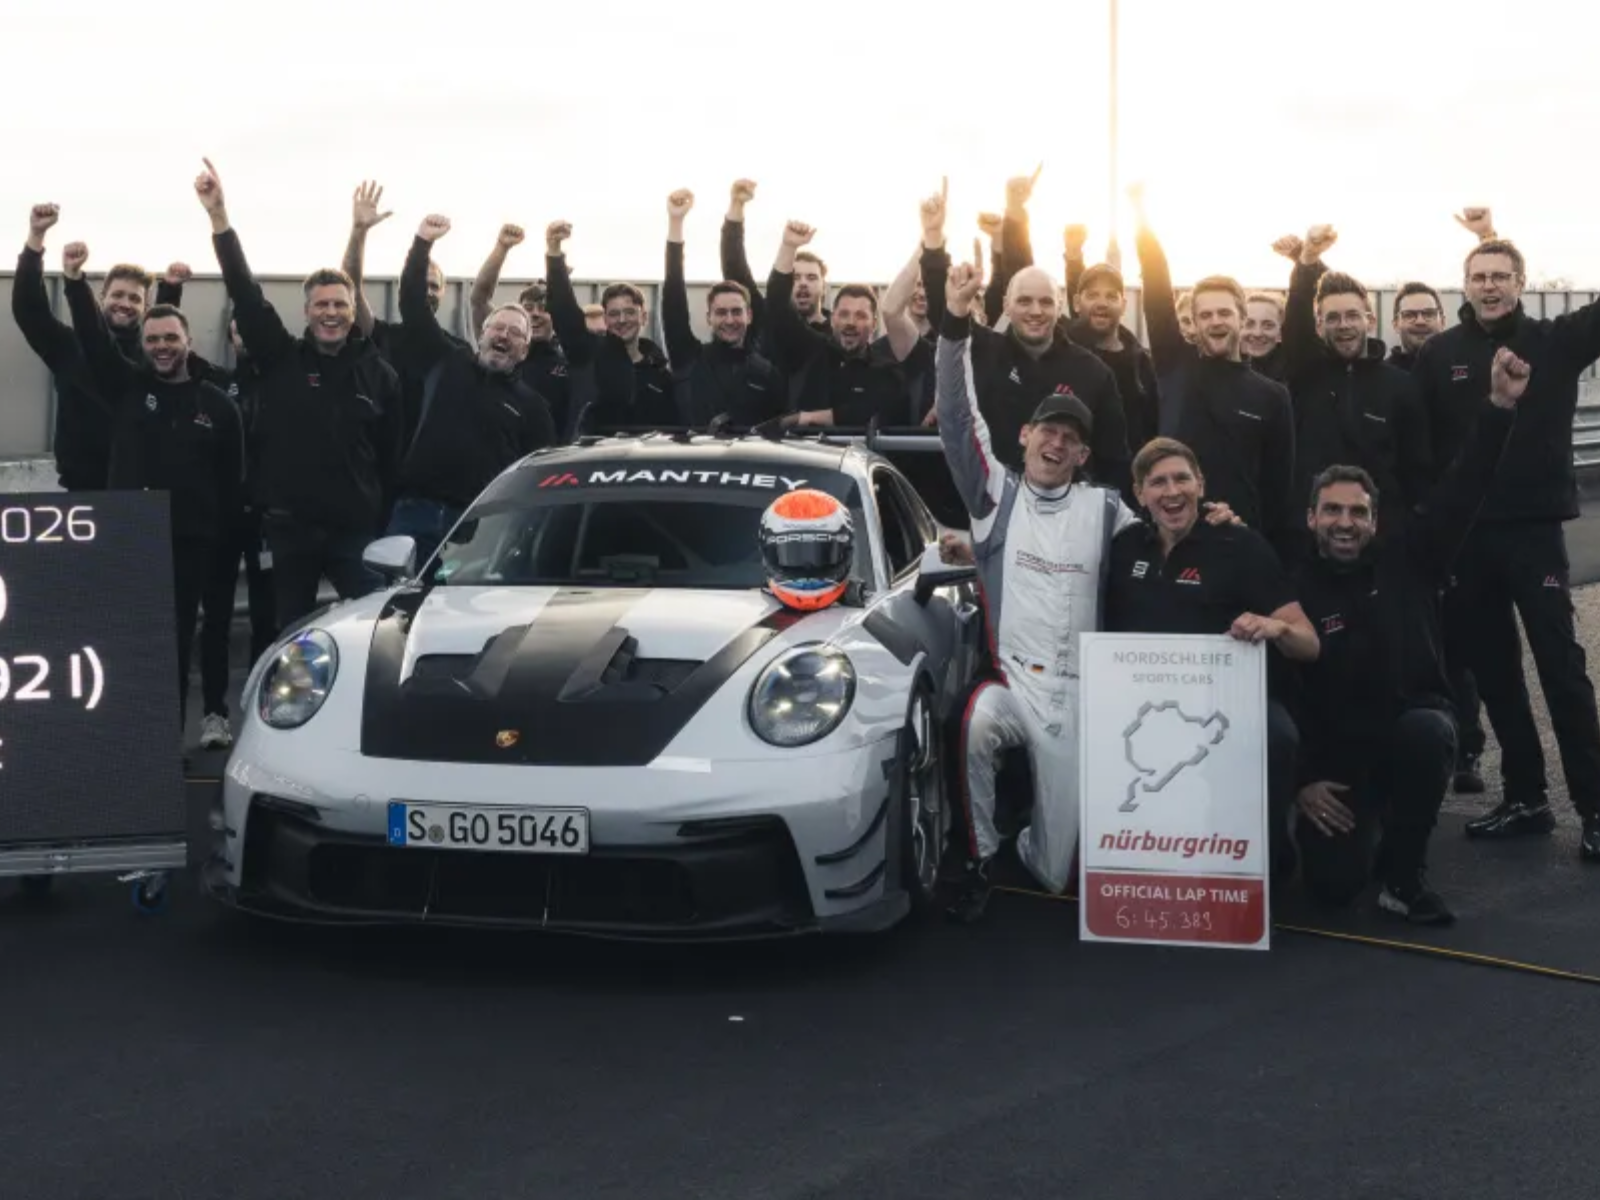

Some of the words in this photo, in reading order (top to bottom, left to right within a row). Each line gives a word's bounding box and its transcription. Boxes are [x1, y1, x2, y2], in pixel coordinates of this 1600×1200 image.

[588, 469, 808, 491] MANTHEY
[1113, 651, 1232, 666] NORDSCHLEIFE
[0, 655, 51, 699] 2
[1132, 673, 1178, 684] SPORTS
[1181, 674, 1214, 684] CARS
[408, 810, 427, 841] S
[449, 812, 490, 845] GO
[498, 814, 580, 847] 5046
[1099, 830, 1249, 860] nürburgring
[1100, 884, 1172, 899] OFFICIAL
[1176, 888, 1206, 901] LAP
[1210, 890, 1249, 903] TIME
